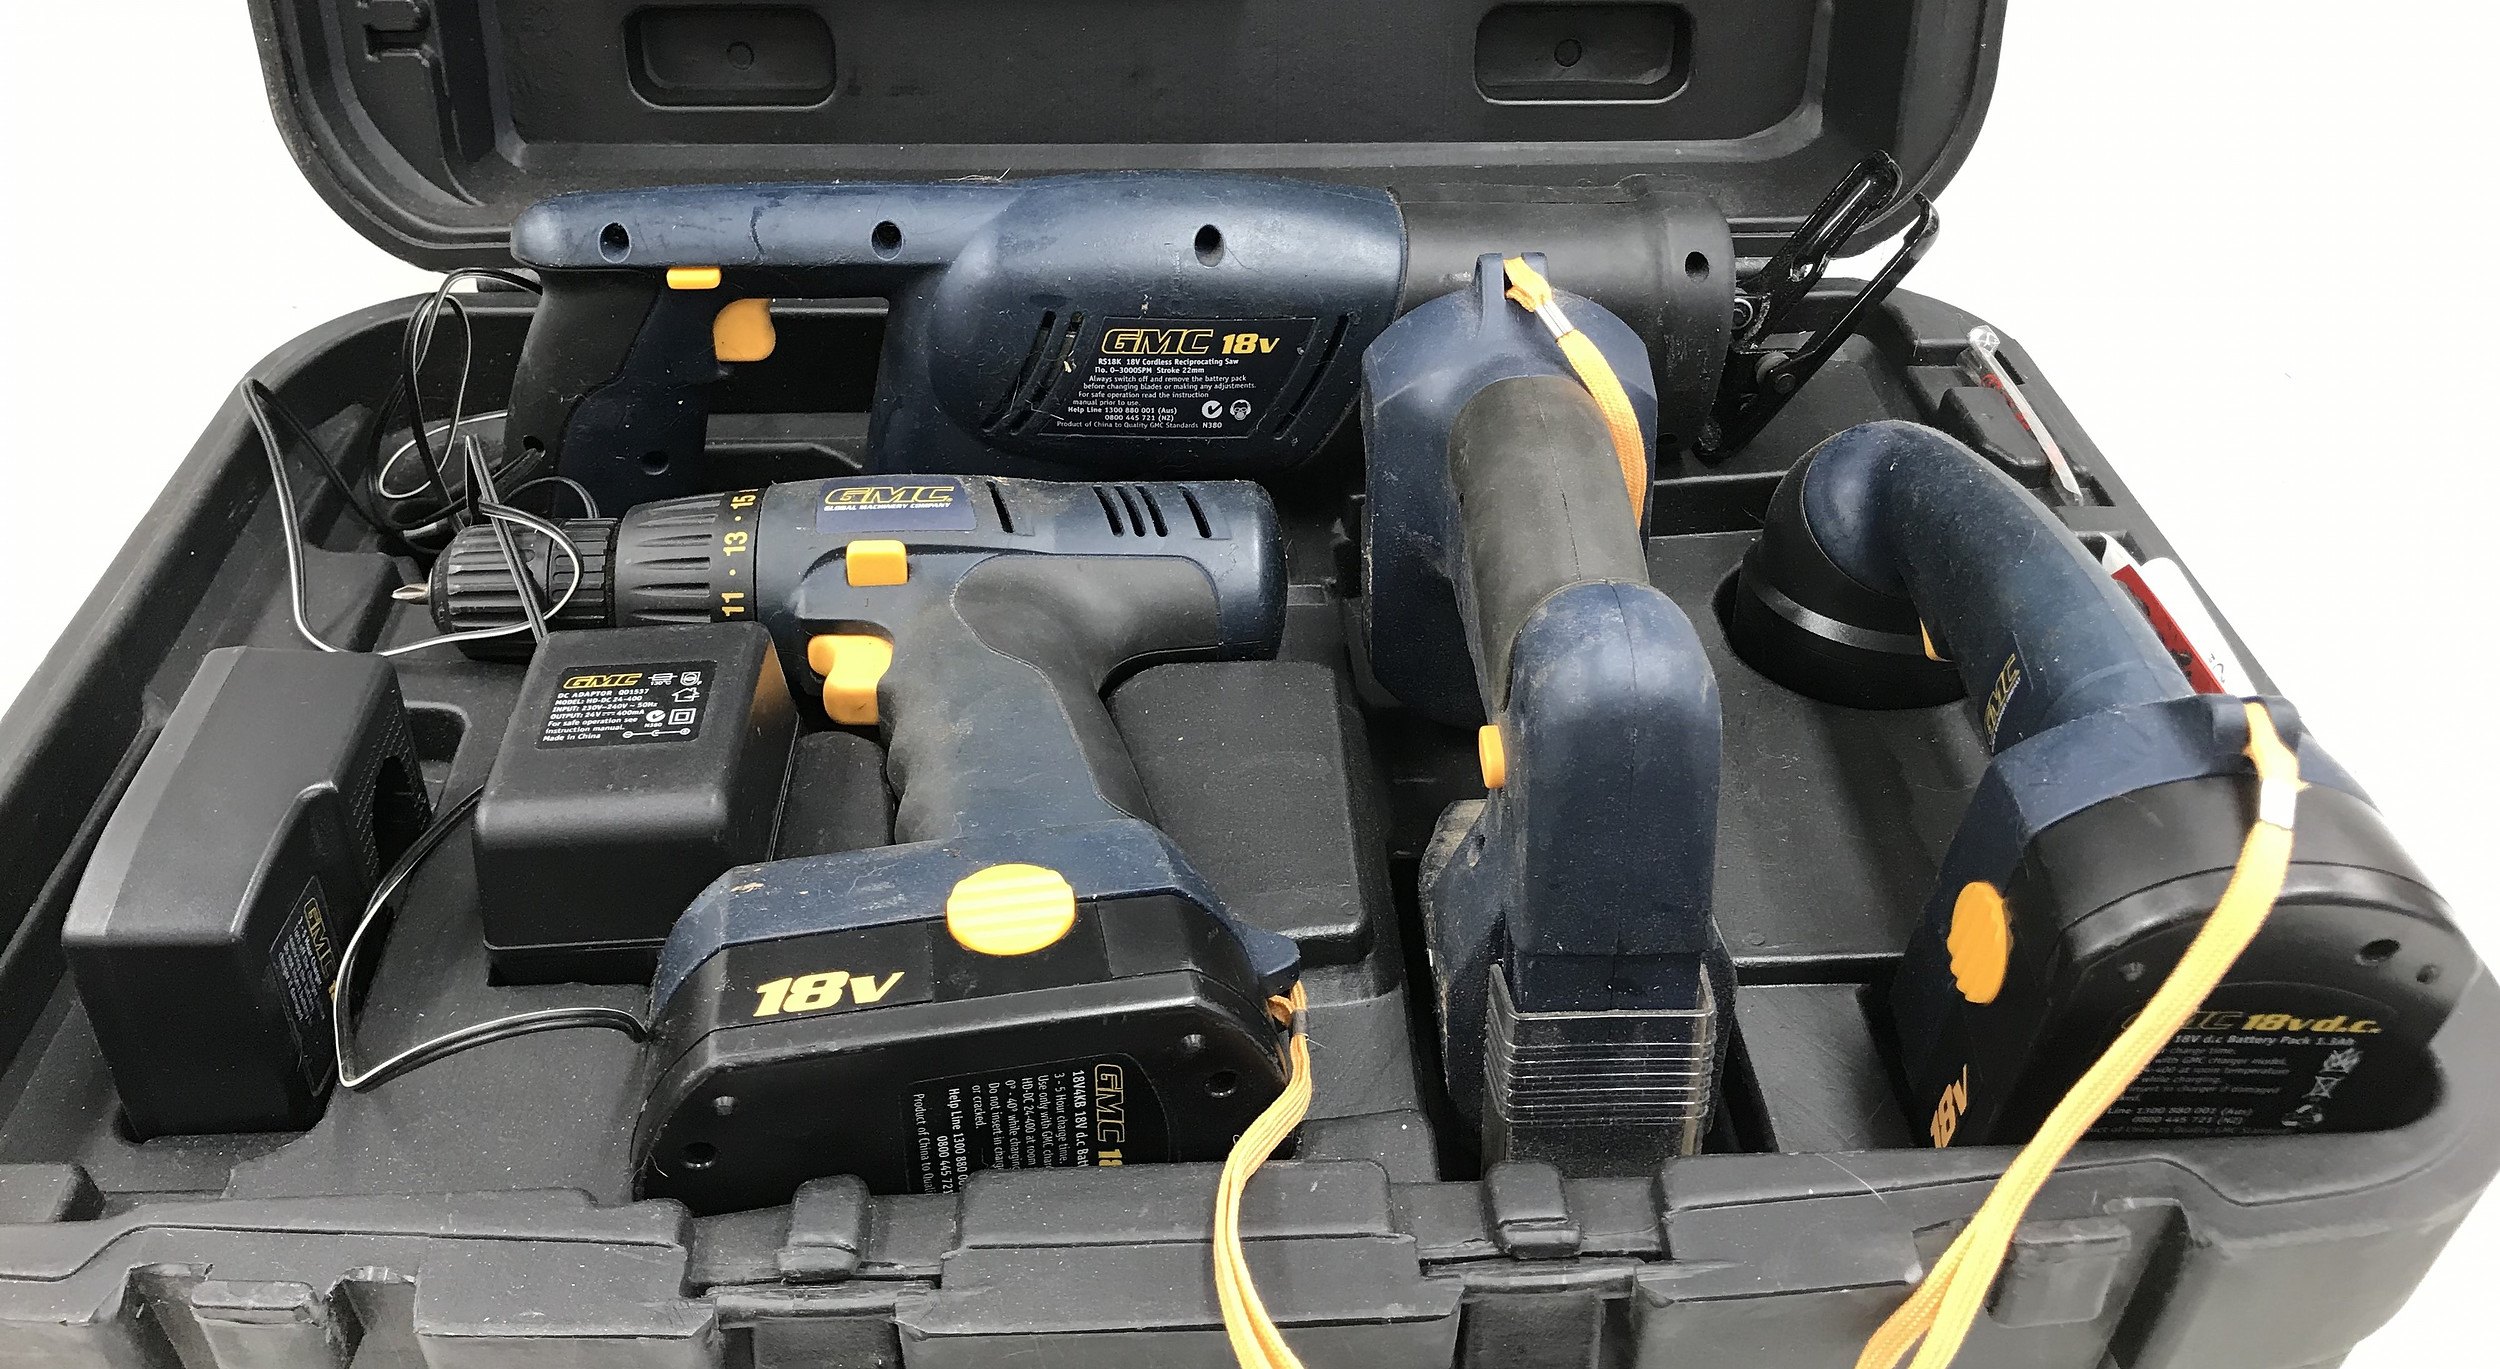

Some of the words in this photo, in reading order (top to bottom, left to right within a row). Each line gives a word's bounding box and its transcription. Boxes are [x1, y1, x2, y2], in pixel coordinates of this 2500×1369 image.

[1101, 328, 1214, 354] GMC
[1174, 358, 1223, 366] Reciprocating
[1083, 382, 1105, 390] before
[1107, 383, 1138, 391] changing
[1173, 383, 1198, 391] making
[1089, 375, 1112, 383] Always
[1205, 375, 1229, 383] battery
[1107, 391, 1139, 399] operation
[1068, 406, 1085, 414] Help
[1158, 407, 1177, 415] (Aus)
[1158, 414, 1174, 422] (NZ)
[1123, 421, 1148, 429] Quality
[730, 495, 756, 510] 15
[825, 486, 954, 505] GMC
[723, 531, 748, 556] 13
[721, 592, 744, 617] 11
[563, 673, 643, 689] GMC
[571, 690, 613, 698] ADAPTOR
[552, 705, 579, 713] INPUT:
[582, 717, 622, 726] operation
[578, 732, 601, 740] China
[304, 897, 336, 979] GMC
[752, 971, 906, 1017] 18v
[972, 1085, 981, 1093] or
[988, 1082, 1000, 1094] Do
[1022, 1078, 1034, 1103] HD-DC
[1038, 1075, 1049, 1090] Use
[1072, 1070, 1087, 1108] 18V4KB
[947, 1088, 961, 1109] Help
[990, 1096, 1001, 1110] not
[1037, 1092, 1051, 1109] only
[1055, 1094, 1067, 1113] Hour
[1094, 1063, 1125, 1143] GMC
[913, 1093, 927, 1126] Product
[973, 1096, 987, 1129] cracked.
[951, 1110, 963, 1130] Line
[1008, 1115, 1020, 1136] while
[1024, 1105, 1036, 1133] 24-400
[1041, 1111, 1052, 1129] with
[1074, 1111, 1088, 1129] 18V
[918, 1127, 930, 1136] of
[1056, 1115, 1068, 1142] charge
[937, 1135, 950, 1158] 0800
[953, 1133, 965, 1154] 1300
[1026, 1136, 1036, 1144] at
[1042, 1131, 1053, 1148] GMC
[1076, 1132, 1088, 1146] d.c
[919, 1137, 931, 1161] China
[993, 1147, 1005, 1169] charg
[1027, 1145, 1036, 1165] room
[1059, 1143, 1070, 1164] time.
[1077, 1148, 1089, 1167] Batt
[921, 1162, 931, 1171] to
[940, 1160, 952, 1176] 445
[956, 1156, 967, 1172] 880
